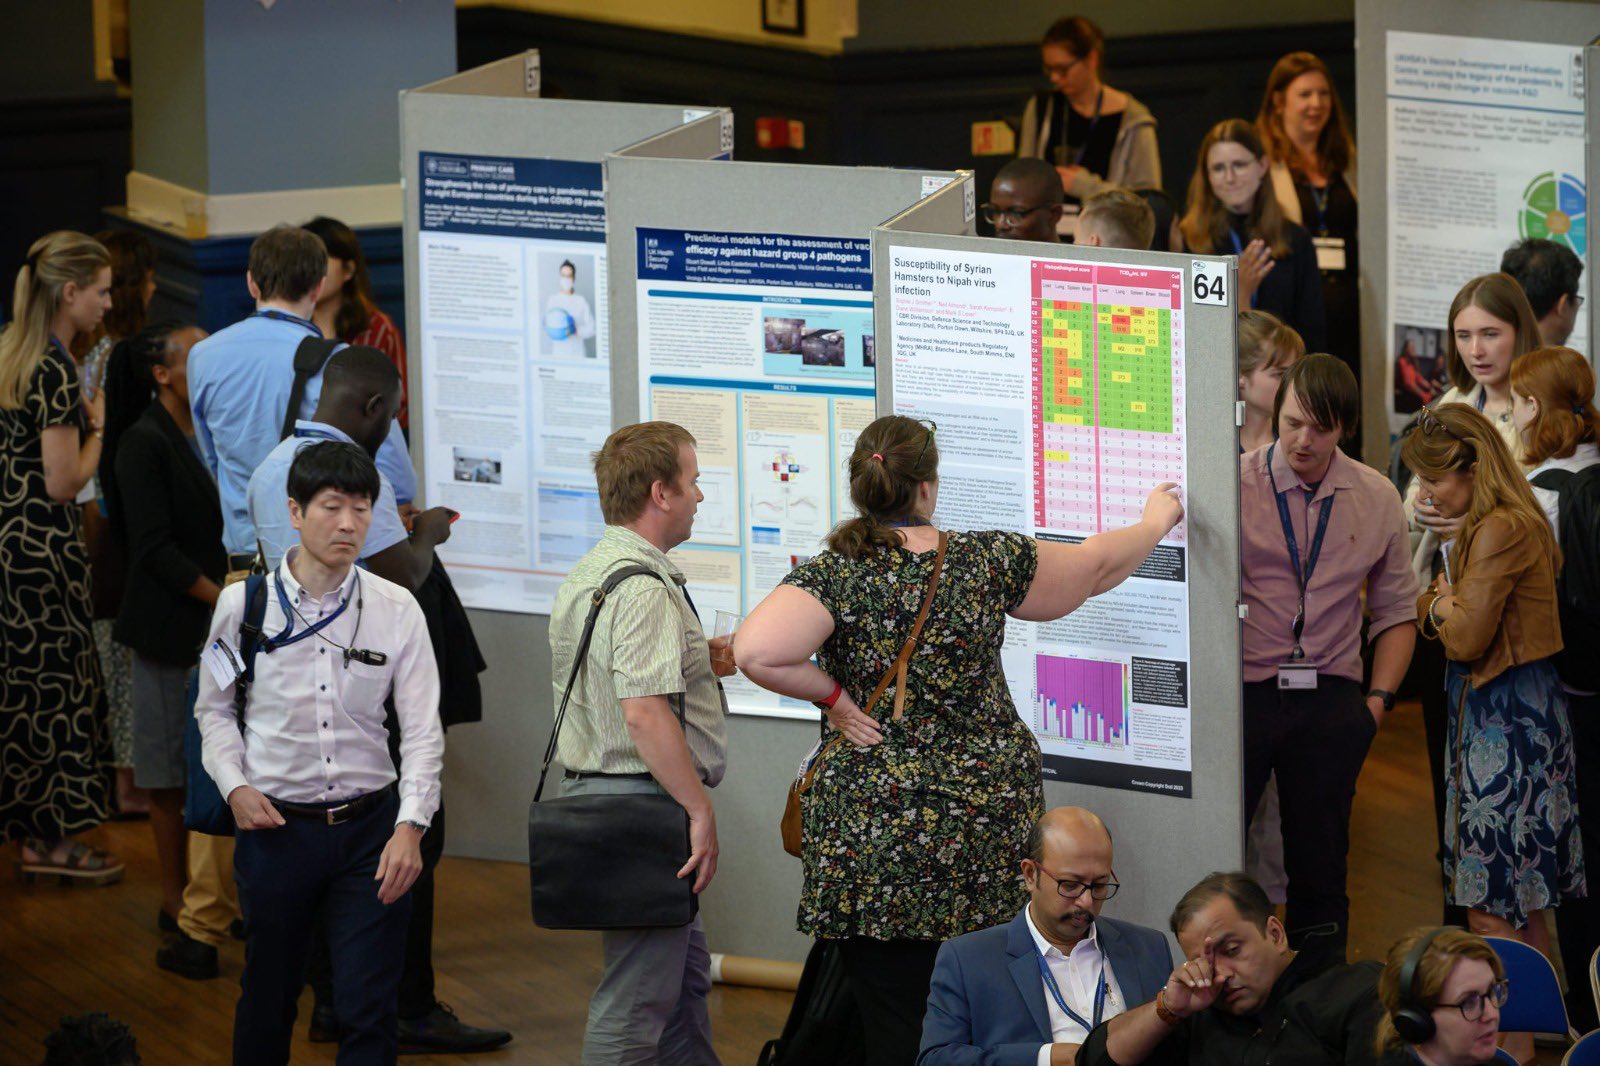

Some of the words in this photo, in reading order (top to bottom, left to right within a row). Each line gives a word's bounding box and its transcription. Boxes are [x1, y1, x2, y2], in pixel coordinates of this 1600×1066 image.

[685, 233, 729, 244] Preclinical
[730, 236, 762, 245] models
[763, 237, 776, 246] for
[776, 238, 790, 247] the
[792, 240, 842, 250] assessment
[844, 241, 854, 250] of
[686, 245, 718, 257] efficacy
[720, 247, 750, 259] against
[752, 248, 781, 258] hazard
[782, 252, 808, 262] group
[809, 251, 815, 260] 4
[817, 252, 862, 263] pathogens
[895, 258, 950, 274] Susceptibility
[953, 263, 962, 272] of
[964, 264, 992, 277] Syrian
[895, 271, 934, 283] Hamsters
[936, 275, 945, 284] to
[947, 276, 972, 288] Nipah
[974, 278, 996, 289] virus
[1194, 274, 1225, 301] 64
[895, 285, 930, 296] infection
[1145, 781, 1164, 789] Copyright
